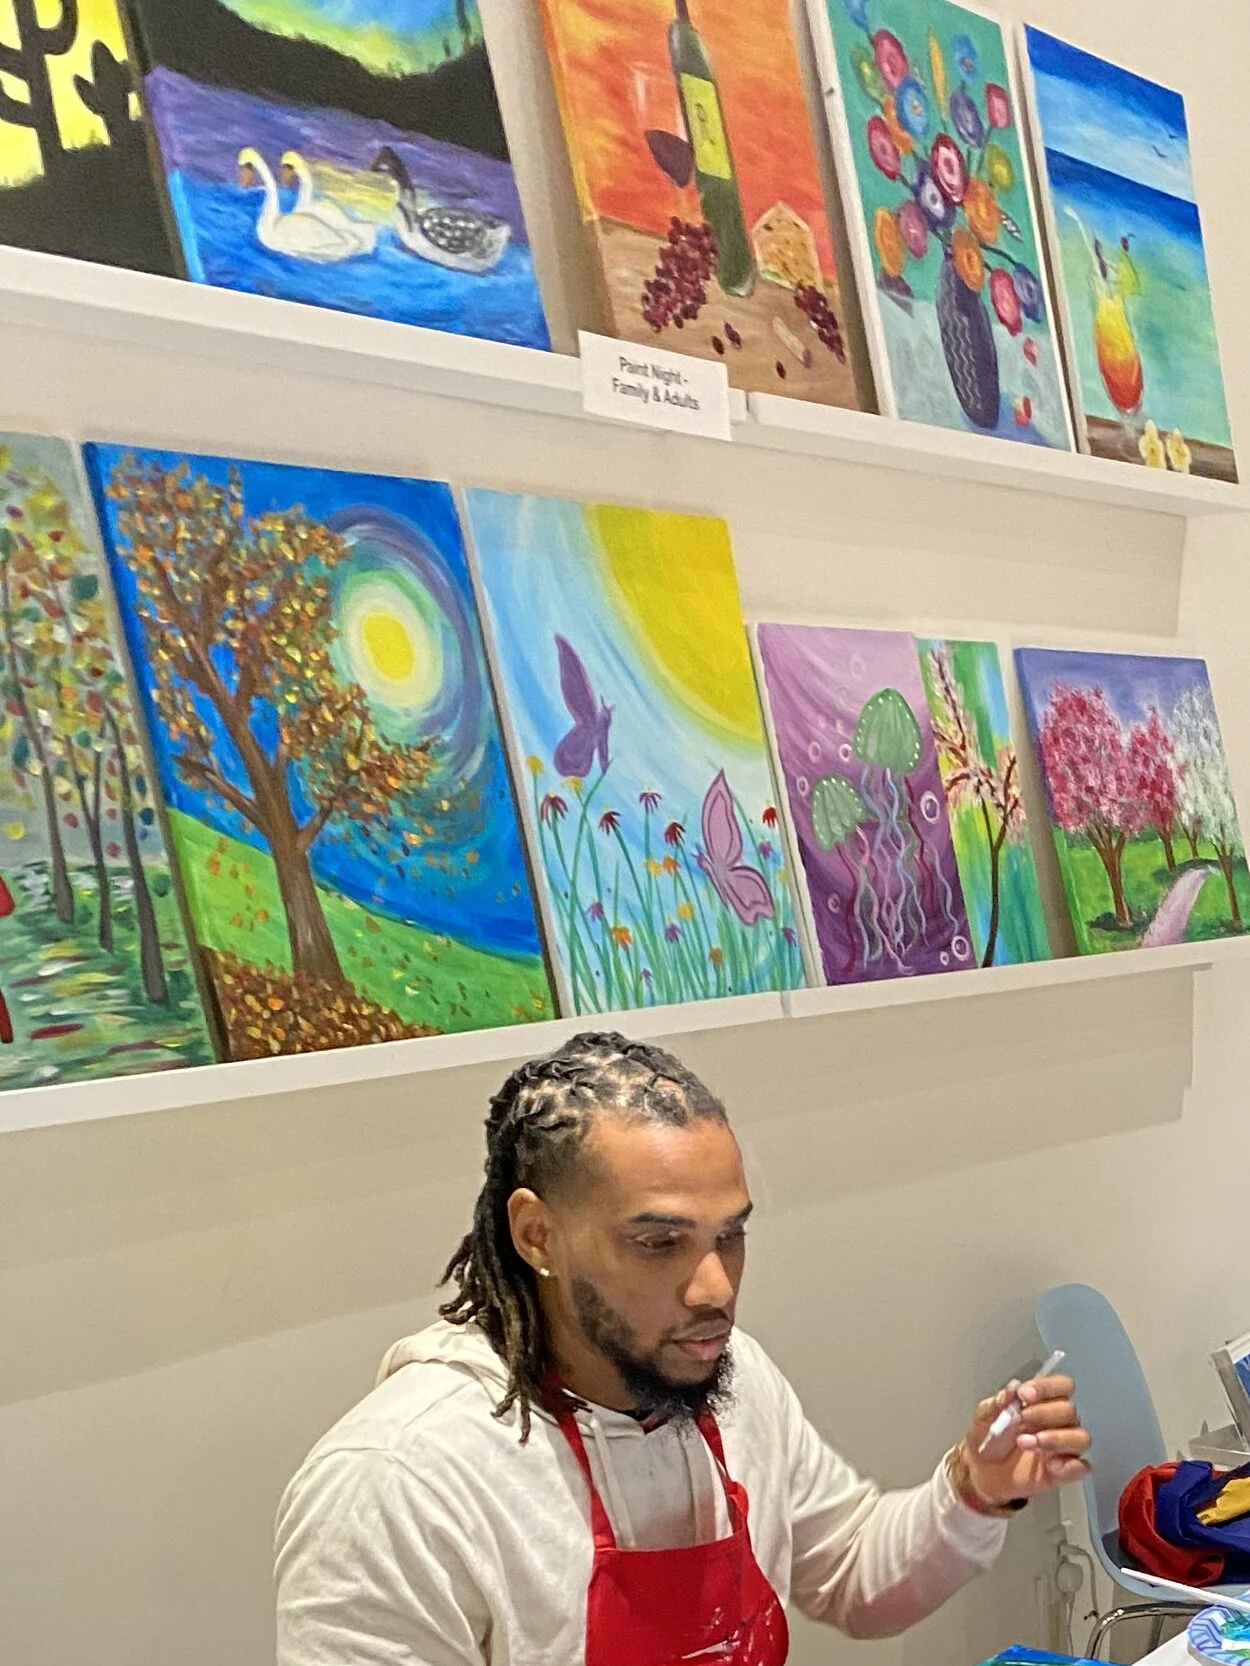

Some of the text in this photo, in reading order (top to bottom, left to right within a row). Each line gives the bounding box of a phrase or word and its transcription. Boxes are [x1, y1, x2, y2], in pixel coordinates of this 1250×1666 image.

[619, 356, 649, 377] Paint
[651, 364, 682, 386] Night
[612, 377, 700, 411] Family & Adults
